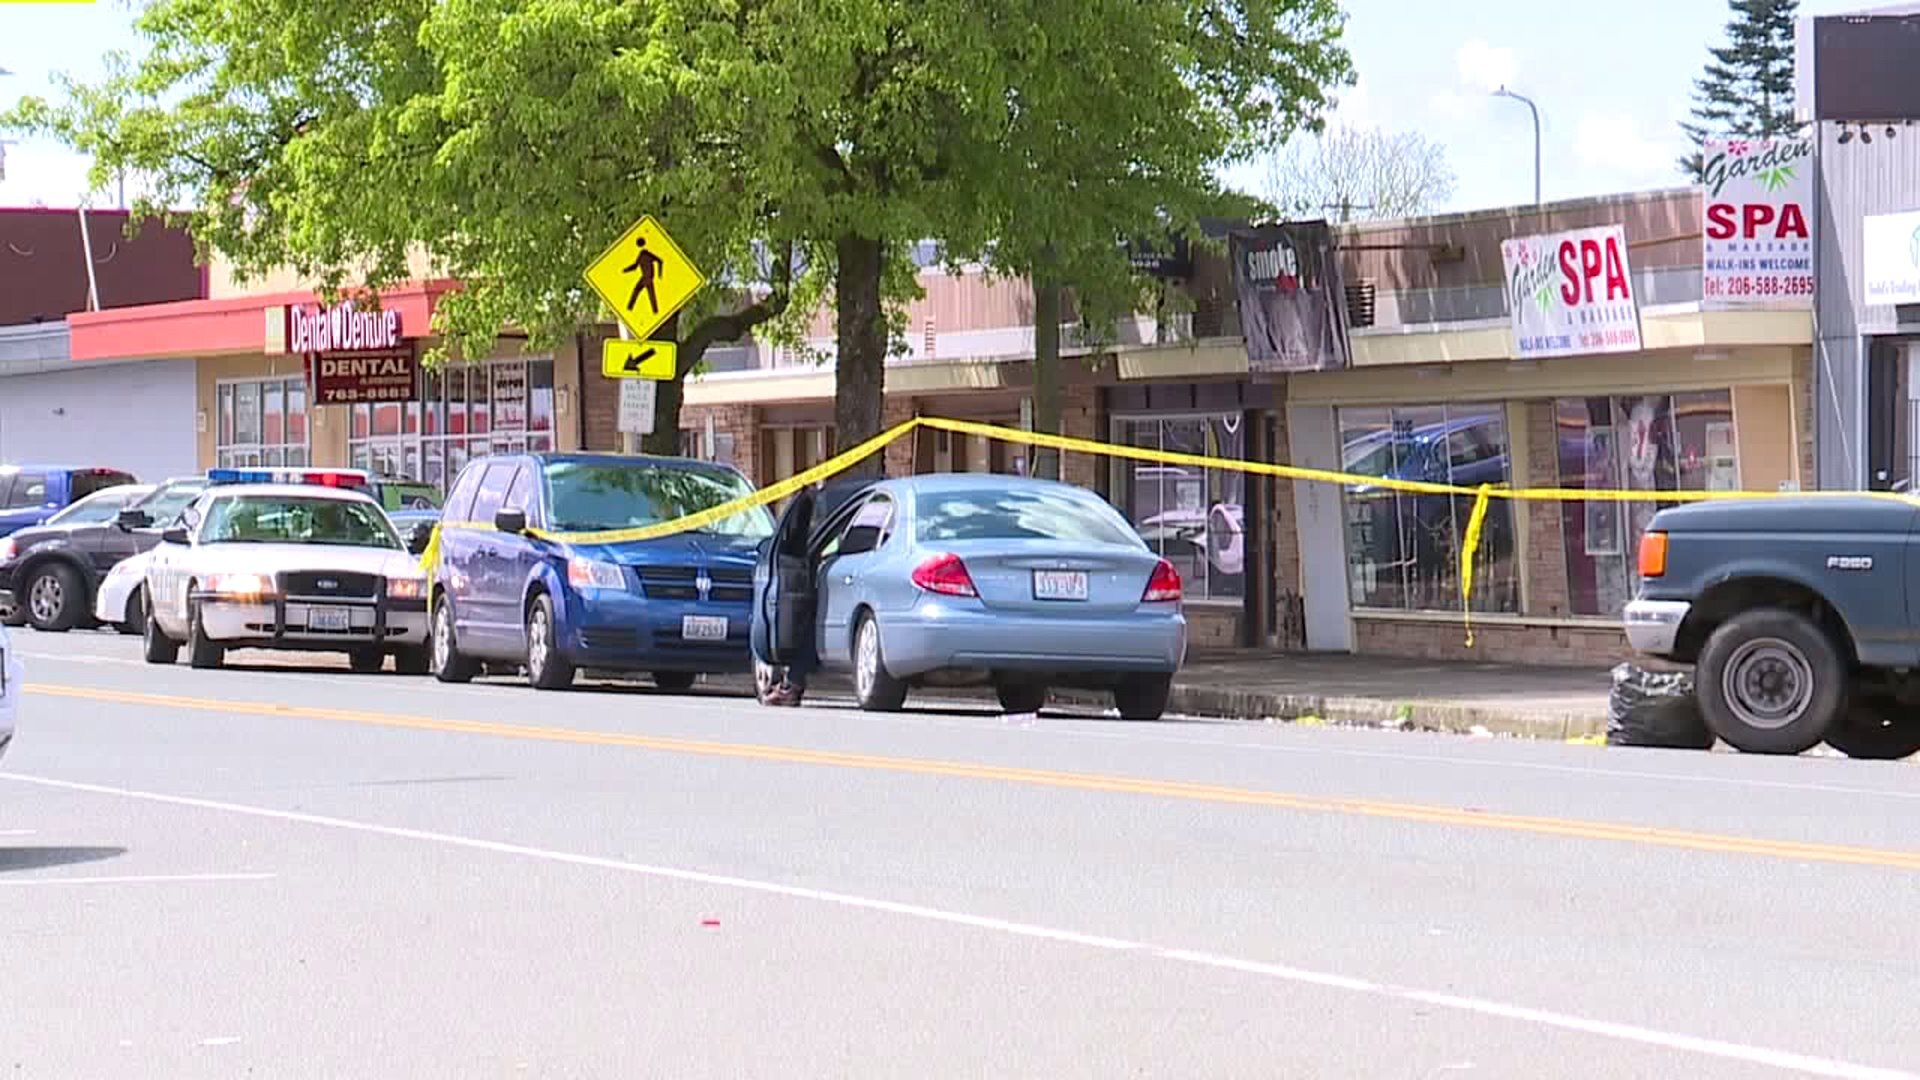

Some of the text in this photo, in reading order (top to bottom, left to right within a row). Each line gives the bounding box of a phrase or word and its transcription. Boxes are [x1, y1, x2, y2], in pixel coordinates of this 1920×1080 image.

[1704, 140, 1810, 198] Garden
[1706, 203, 1809, 240] SPA
[1249, 243, 1297, 281] smoke
[1558, 237, 1629, 306] SPA
[1706, 258, 1810, 271] WALK-INS WELCOME
[1705, 276, 1814, 296] Tel: 206-588-2695
[291, 301, 396, 353] Dental Denture
[321, 357, 410, 377] DENTAL
